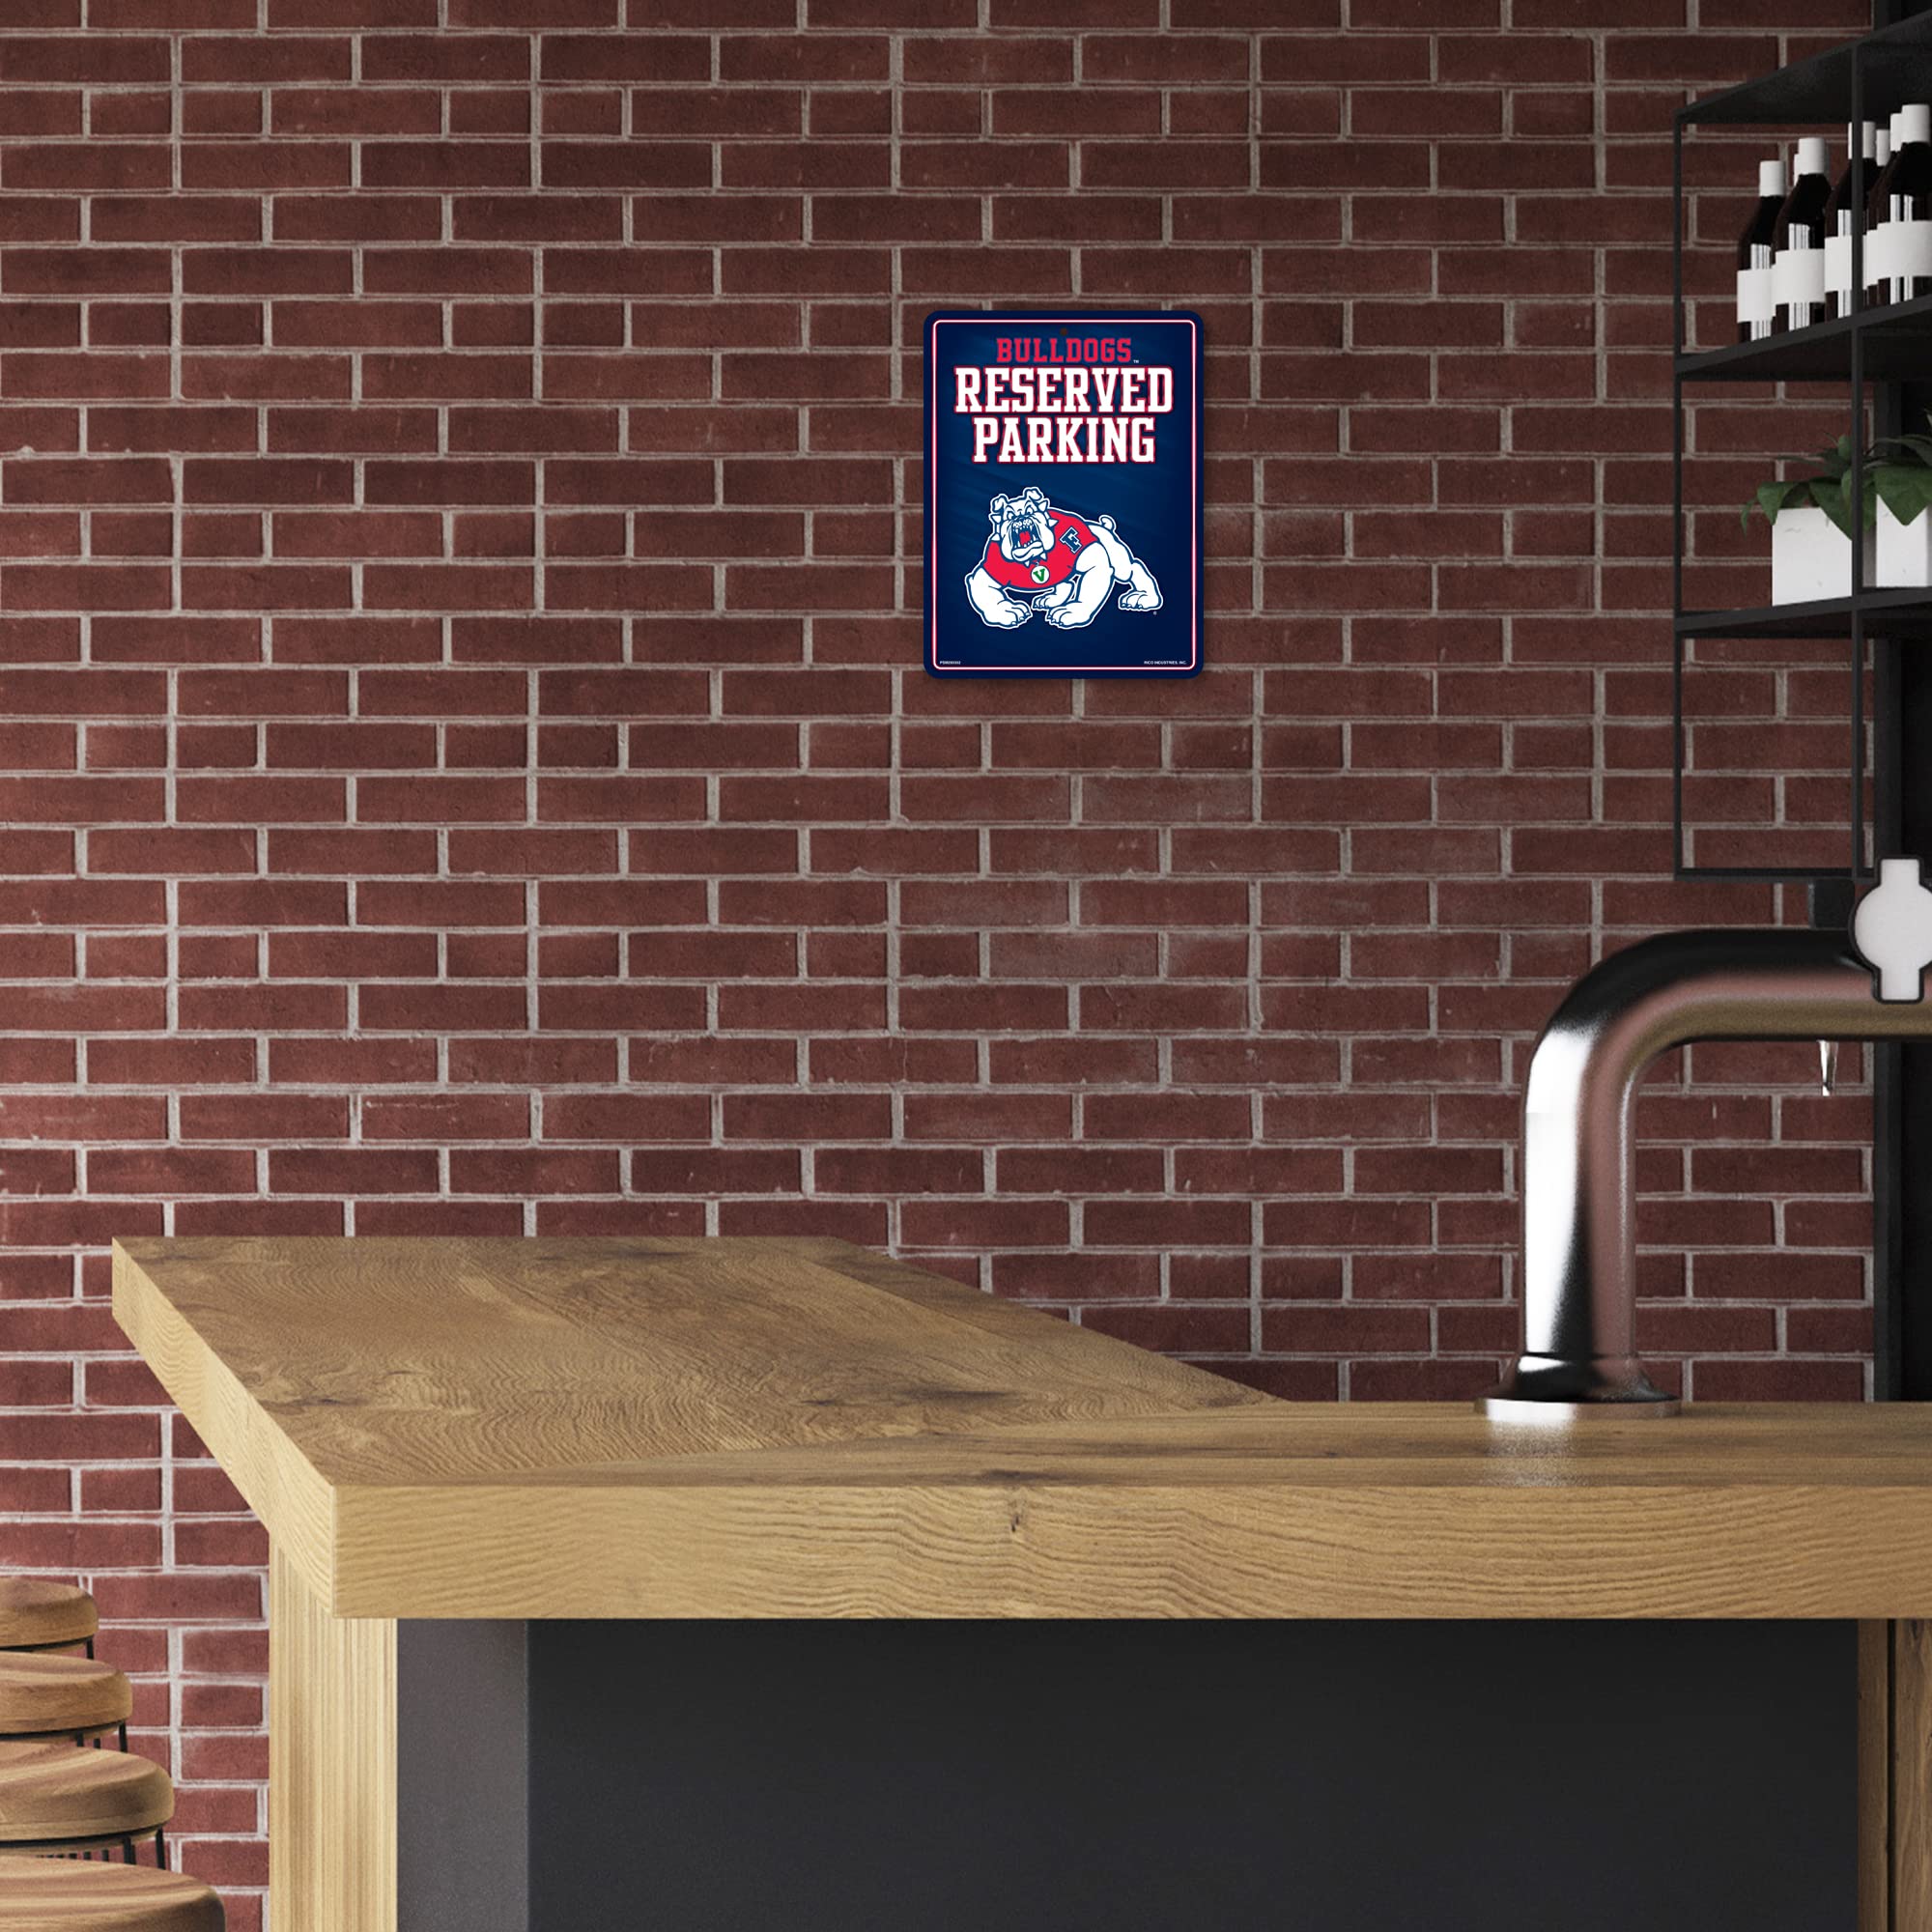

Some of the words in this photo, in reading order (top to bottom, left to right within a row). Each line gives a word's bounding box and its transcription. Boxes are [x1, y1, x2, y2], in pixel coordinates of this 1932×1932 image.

[996, 338, 1131, 362] BULLDOGS
[953, 366, 1174, 413] RESERVED
[972, 416, 1156, 464] PARKING
[1033, 568, 1045, 582] V
